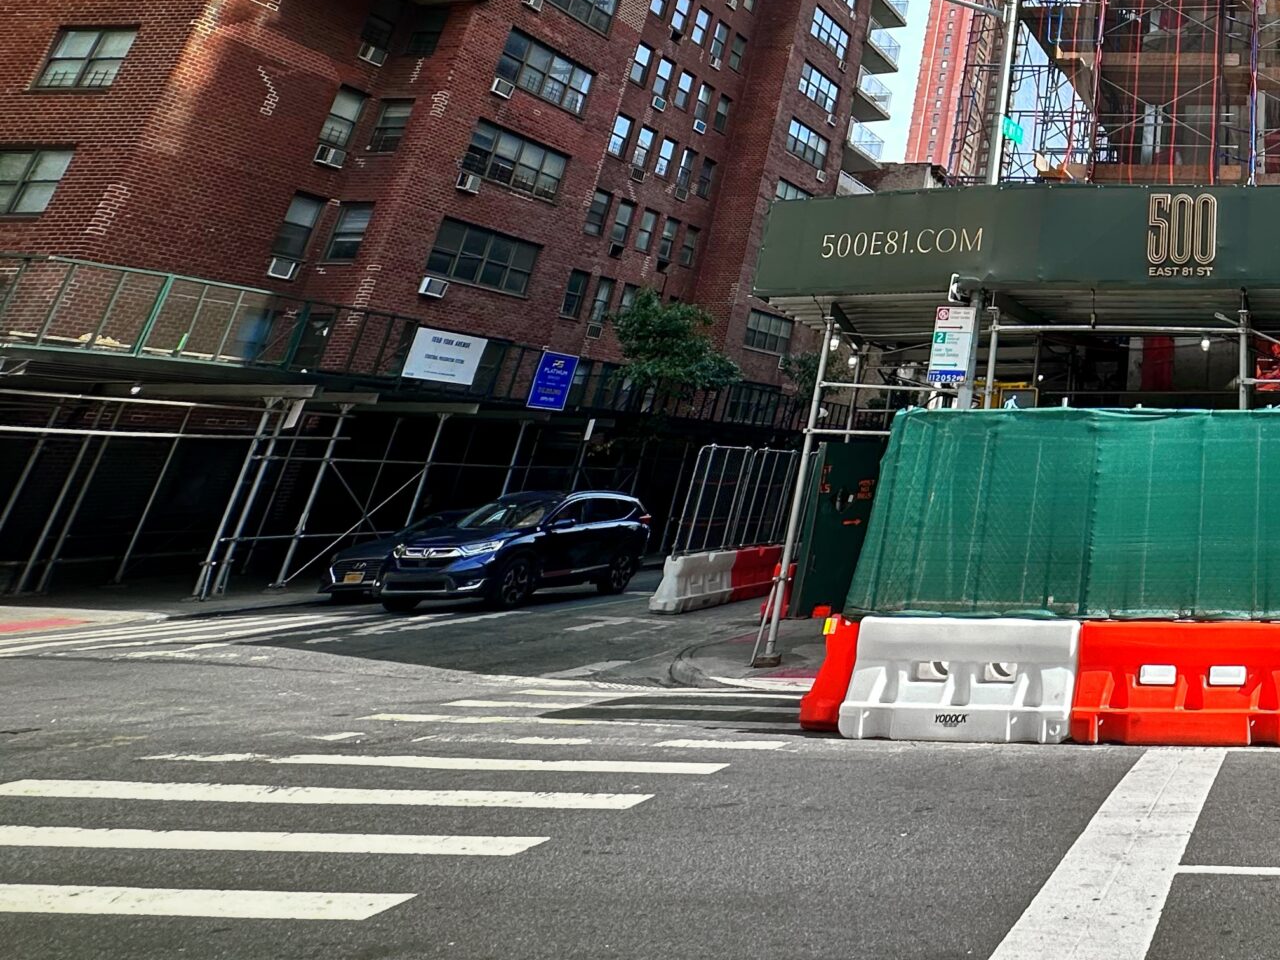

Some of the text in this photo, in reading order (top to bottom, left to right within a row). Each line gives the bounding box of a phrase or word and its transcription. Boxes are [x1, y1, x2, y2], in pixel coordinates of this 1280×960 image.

[1147, 193, 1217, 265] 500
[821, 227, 983, 259] 500E81.COM
[1148, 267, 1213, 276] EAST 81 ST
[936, 332, 943, 343] 2
[935, 713, 969, 723] YODOCK
